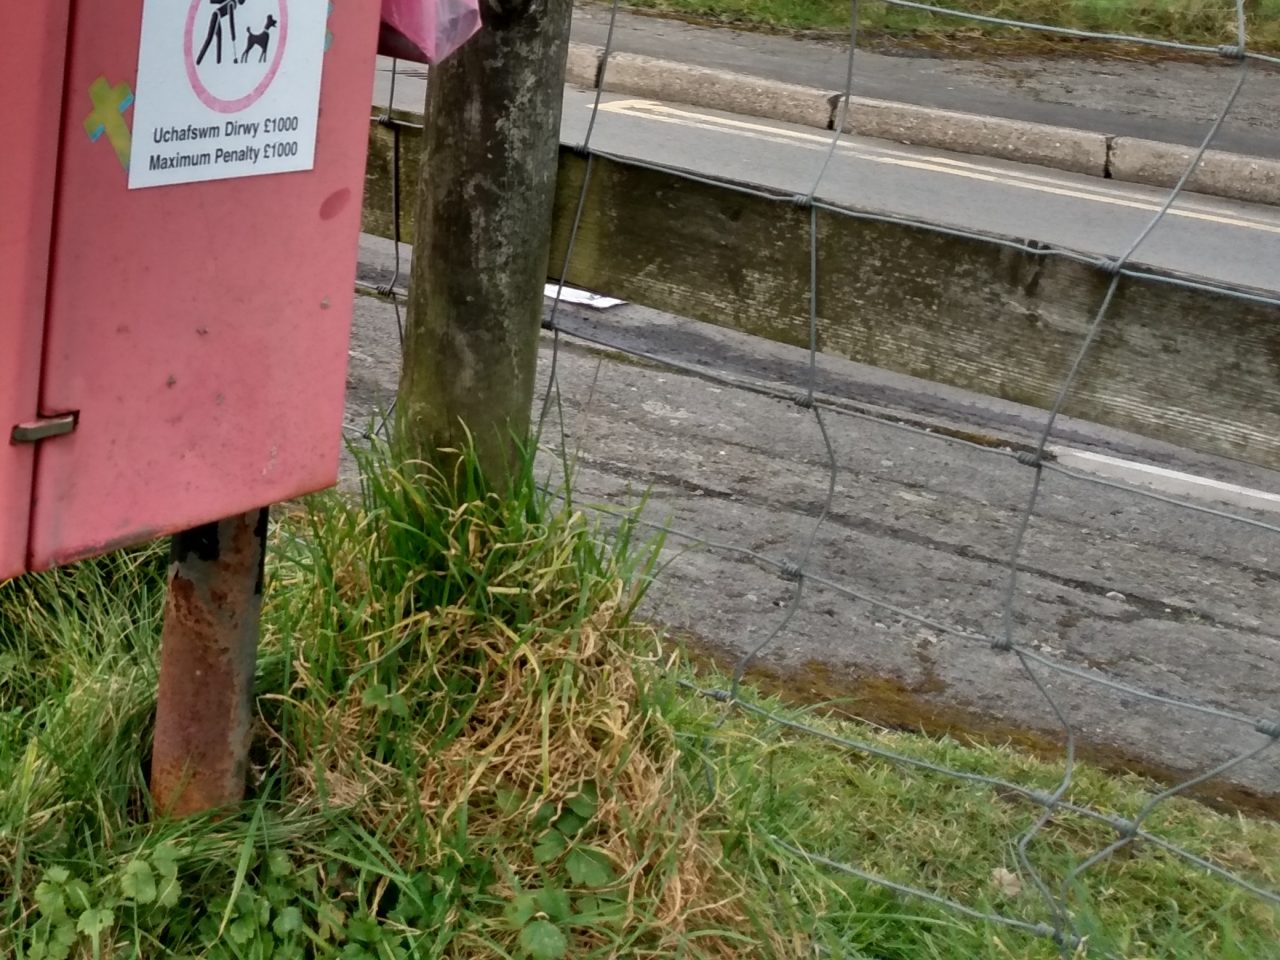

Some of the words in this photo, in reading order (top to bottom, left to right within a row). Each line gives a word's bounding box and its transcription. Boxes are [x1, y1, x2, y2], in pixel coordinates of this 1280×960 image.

[153, 124, 220, 143] Uchafswm
[224, 121, 260, 138] Dirwy
[263, 116, 299, 133] £1000
[149, 152, 211, 171] Maximum
[214, 145, 260, 164] Penalty
[263, 141, 298, 159] £1000
